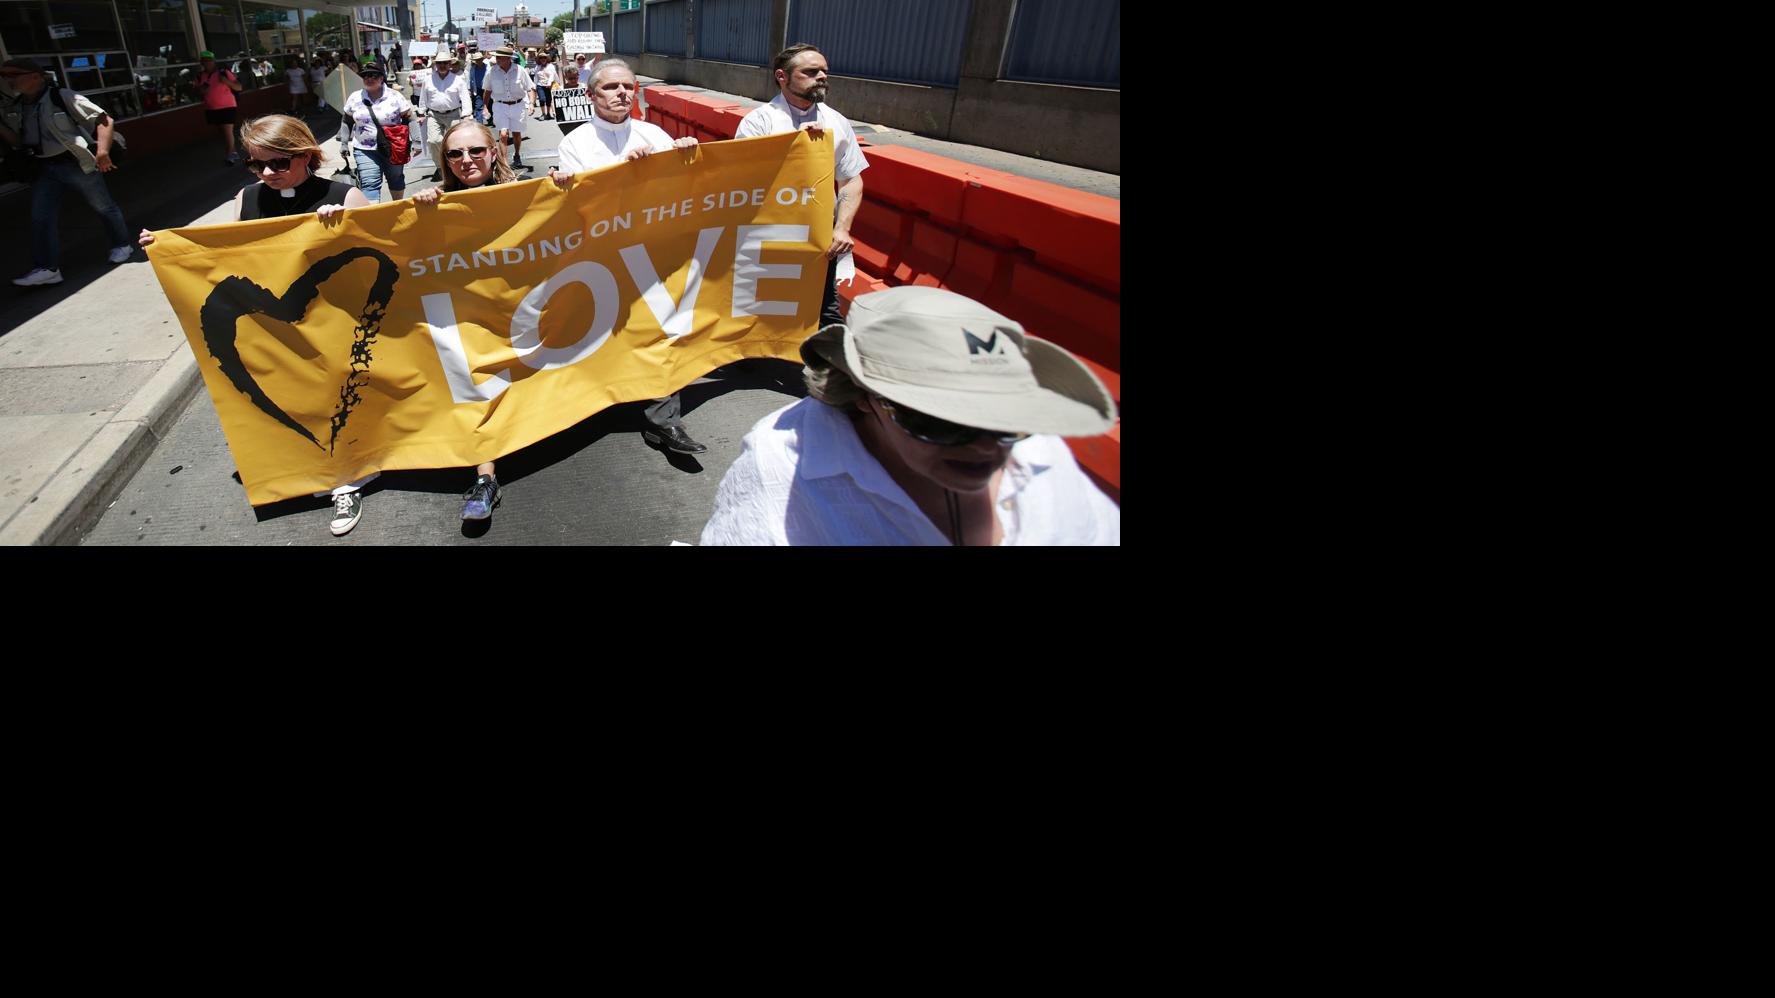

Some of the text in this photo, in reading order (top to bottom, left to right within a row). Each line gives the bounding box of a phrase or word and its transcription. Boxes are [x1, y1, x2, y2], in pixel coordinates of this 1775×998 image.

[555, 97, 568, 108] NO
[408, 186, 816, 277] STANDING ON THE SIDE OF
[420, 224, 809, 404] LOVE
